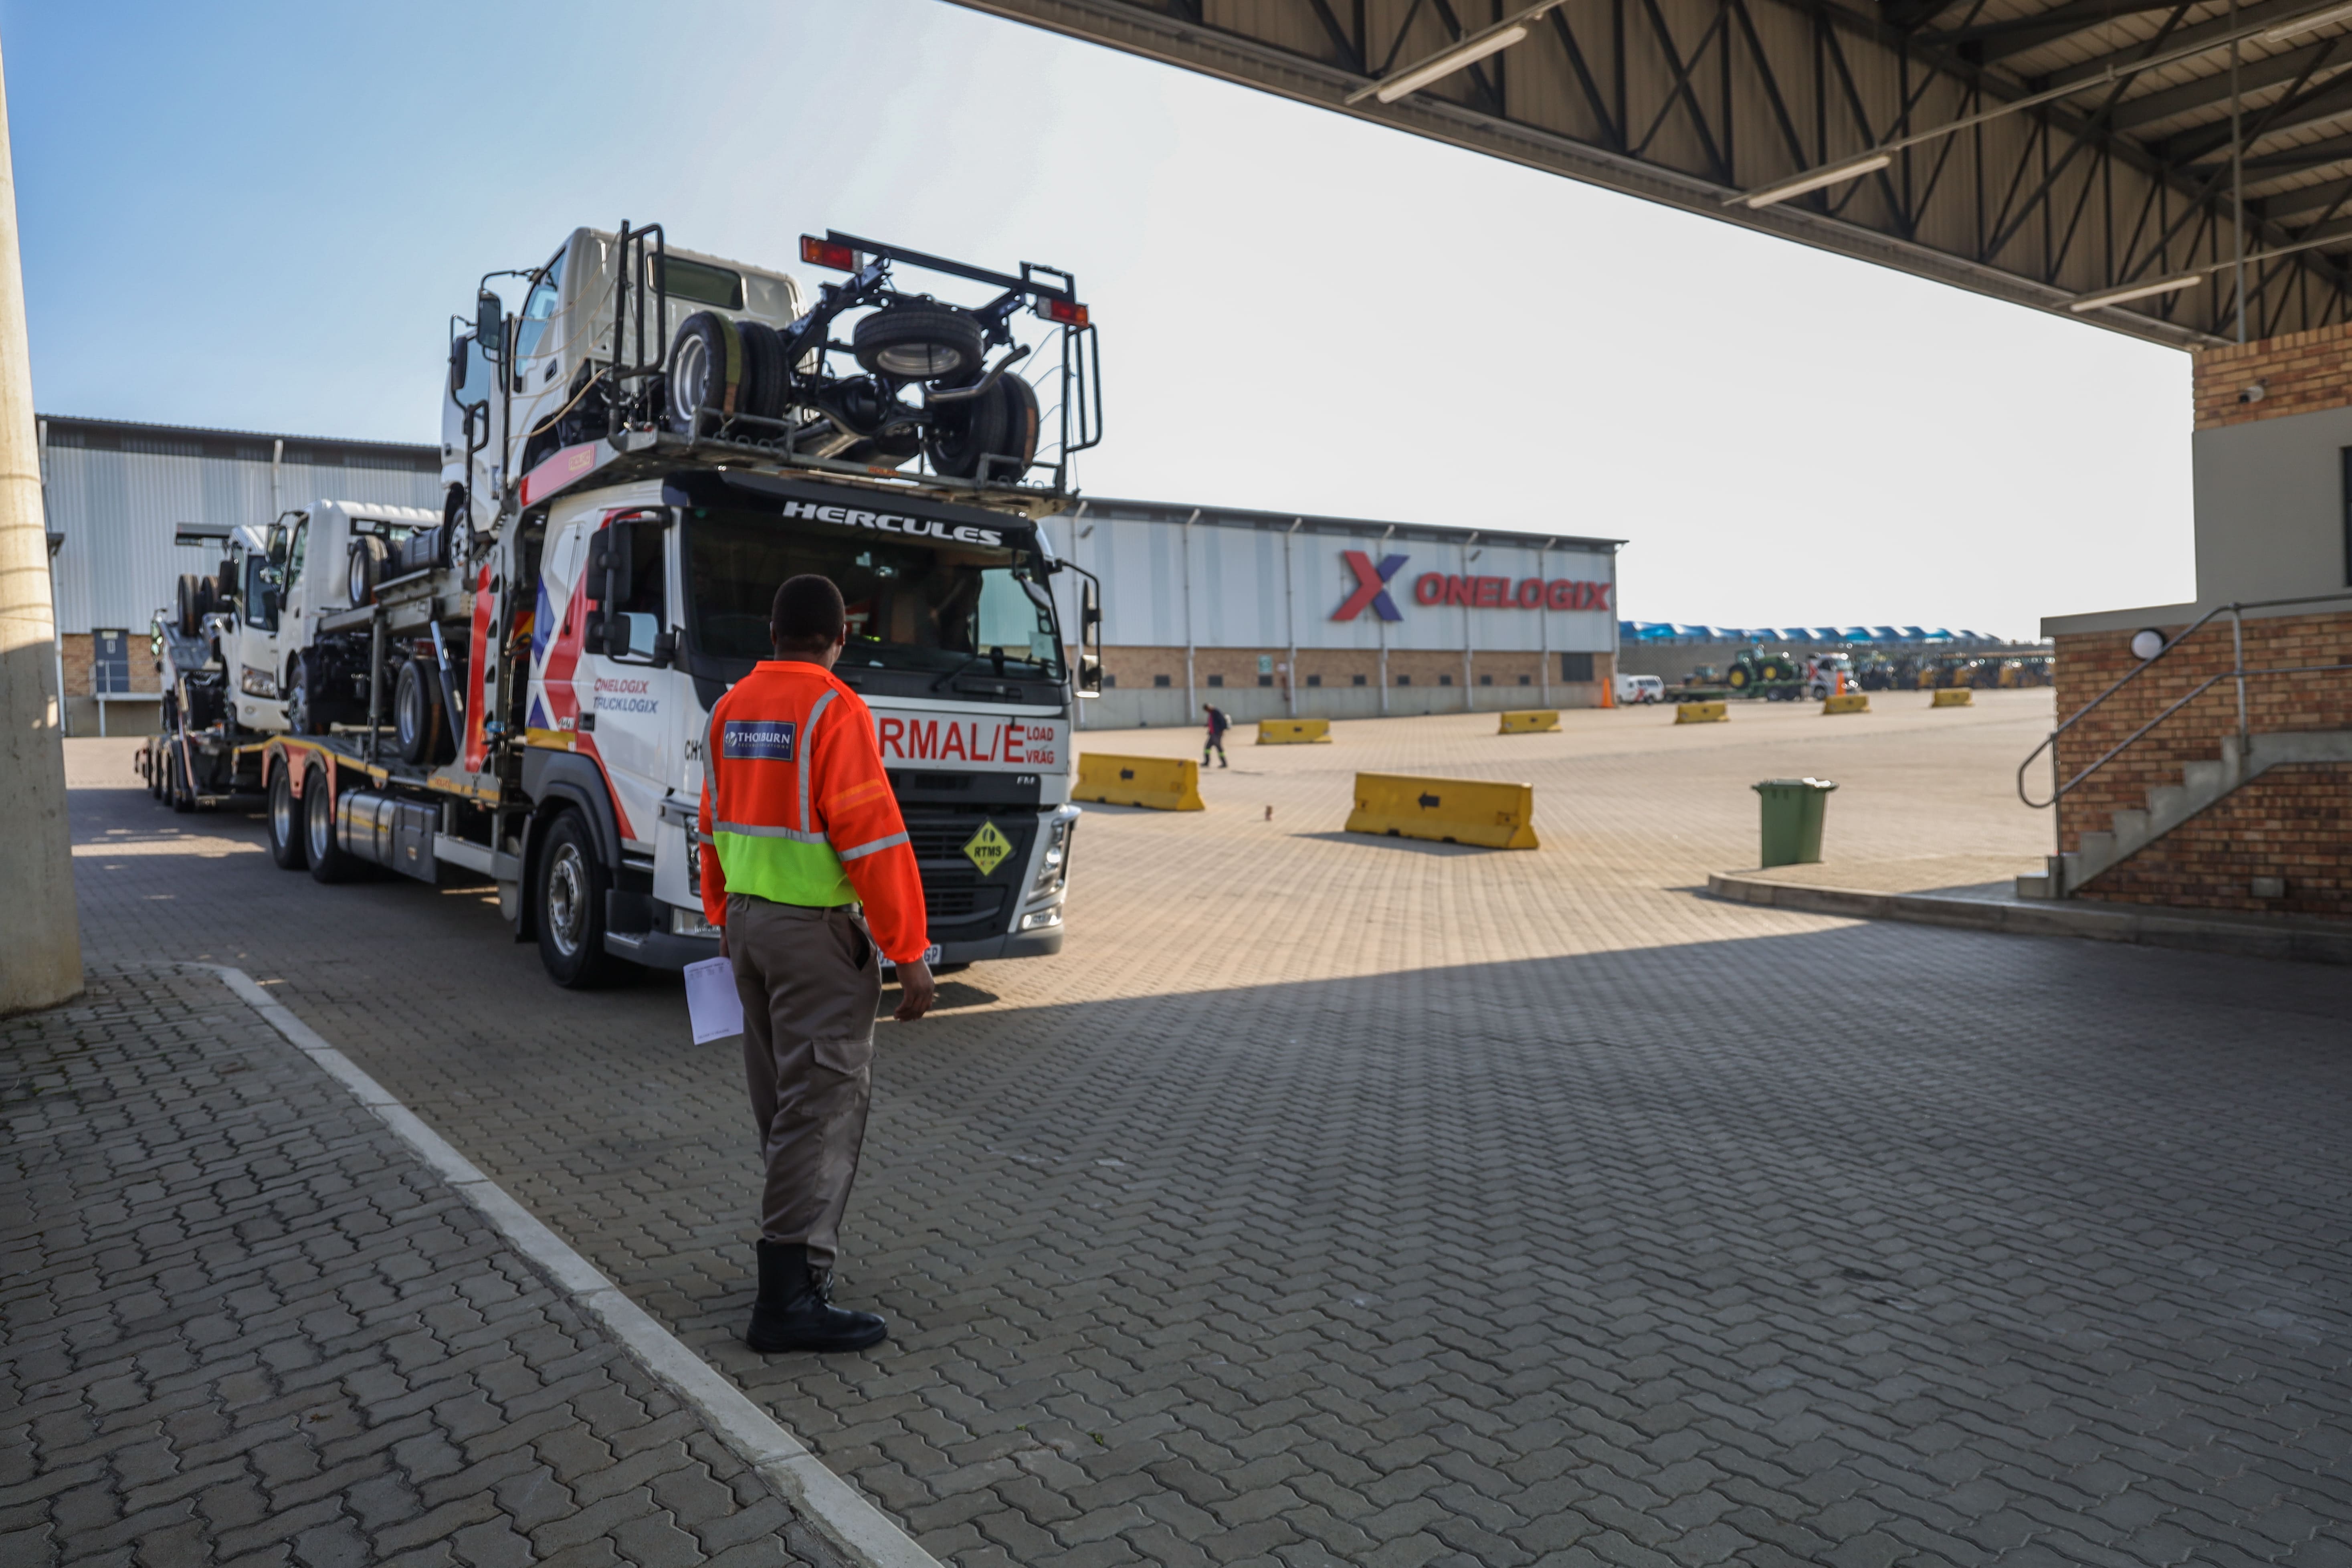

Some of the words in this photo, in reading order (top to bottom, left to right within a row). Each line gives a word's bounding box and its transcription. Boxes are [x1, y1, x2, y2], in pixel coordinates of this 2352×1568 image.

[783, 501, 1002, 546] HERCULES
[1416, 572, 1612, 611] ONELOGIX
[594, 678, 650, 694] ONELOGIX
[594, 697, 659, 713] TRUCKLOGIX
[879, 718, 1024, 763] RMAL/E
[1027, 727, 1054, 741] LOAD
[685, 740, 703, 761] CH1
[1026, 749, 1054, 765] VRAG
[1017, 776, 1035, 784] FM
[974, 846, 1001, 857] RTMS
